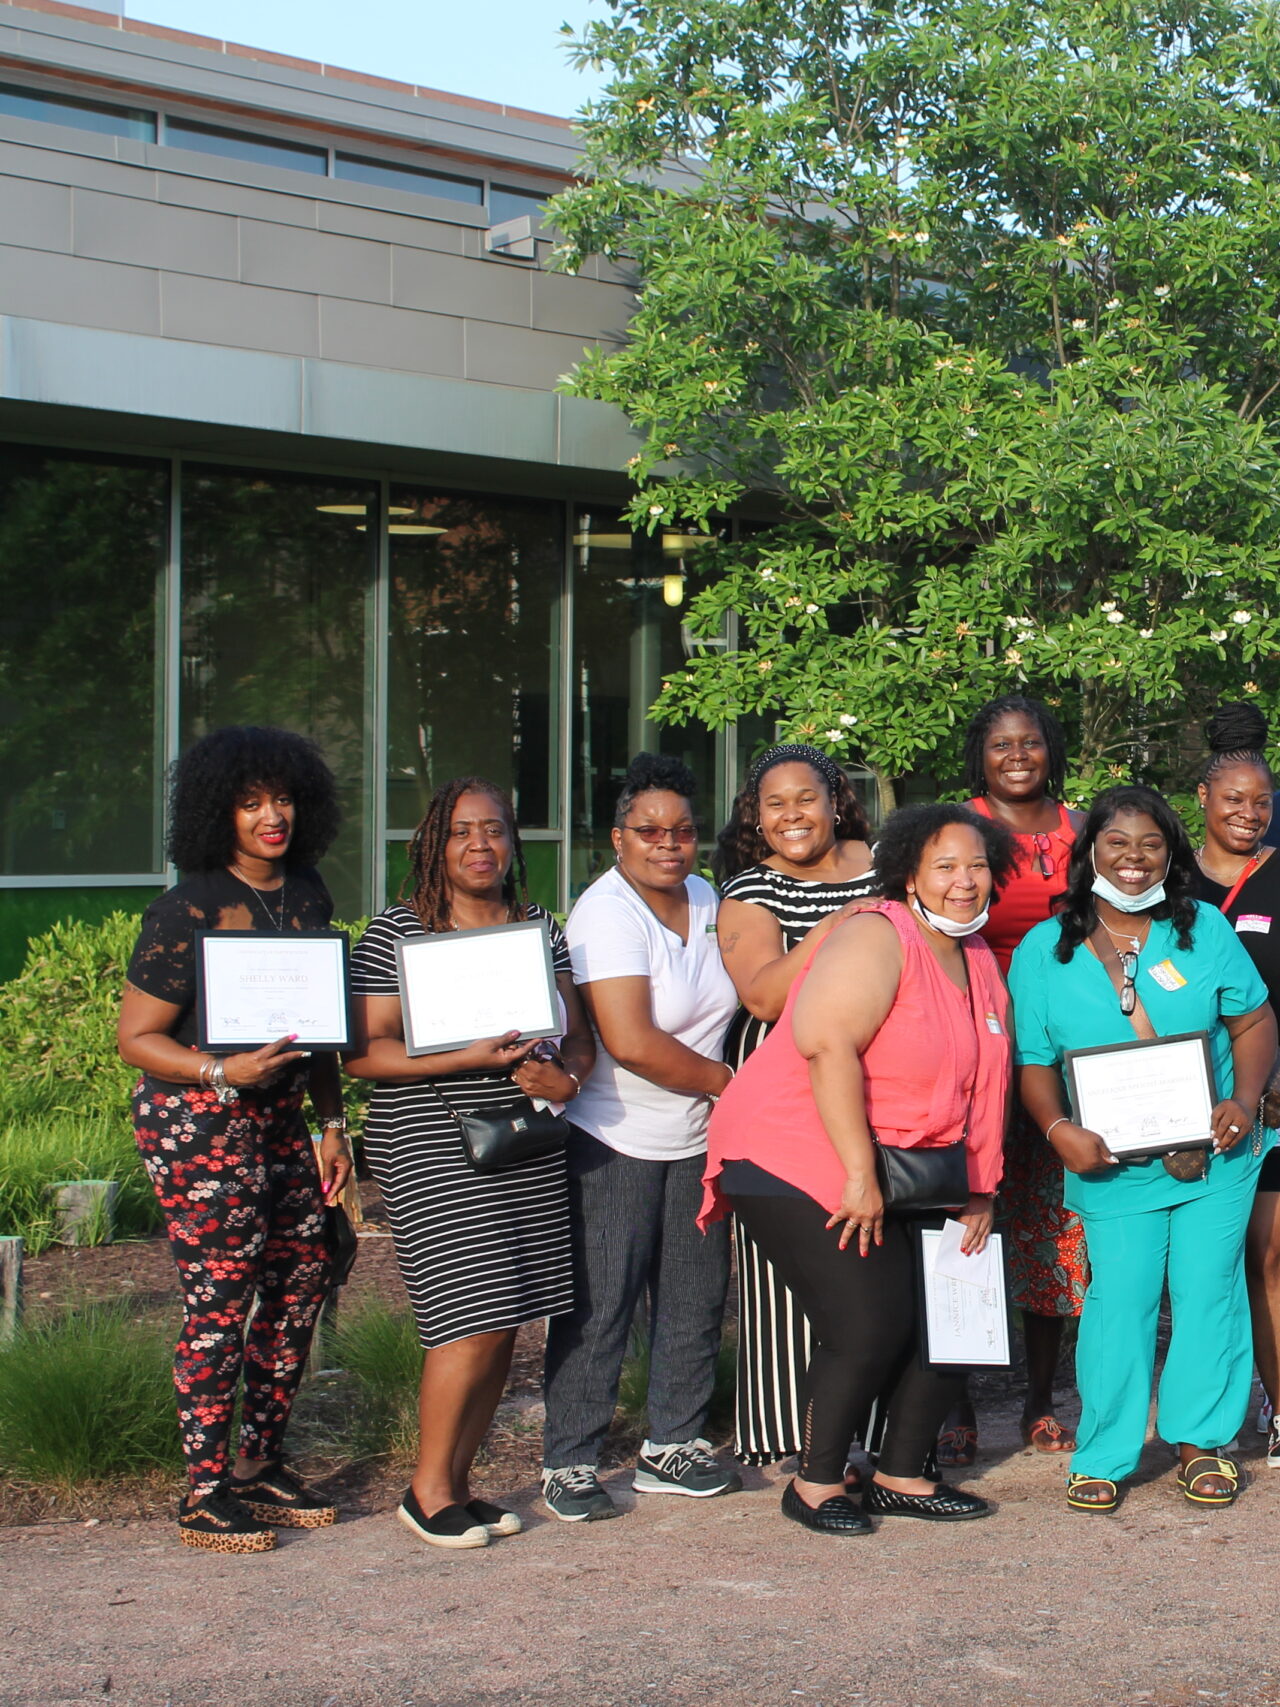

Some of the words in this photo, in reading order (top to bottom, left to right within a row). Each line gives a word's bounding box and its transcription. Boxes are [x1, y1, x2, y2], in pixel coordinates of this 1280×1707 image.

[239, 974, 274, 983] SHELLY
[278, 974, 309, 983] WARD
[663, 1453, 692, 1481] N
[546, 1481, 563, 1502] N
